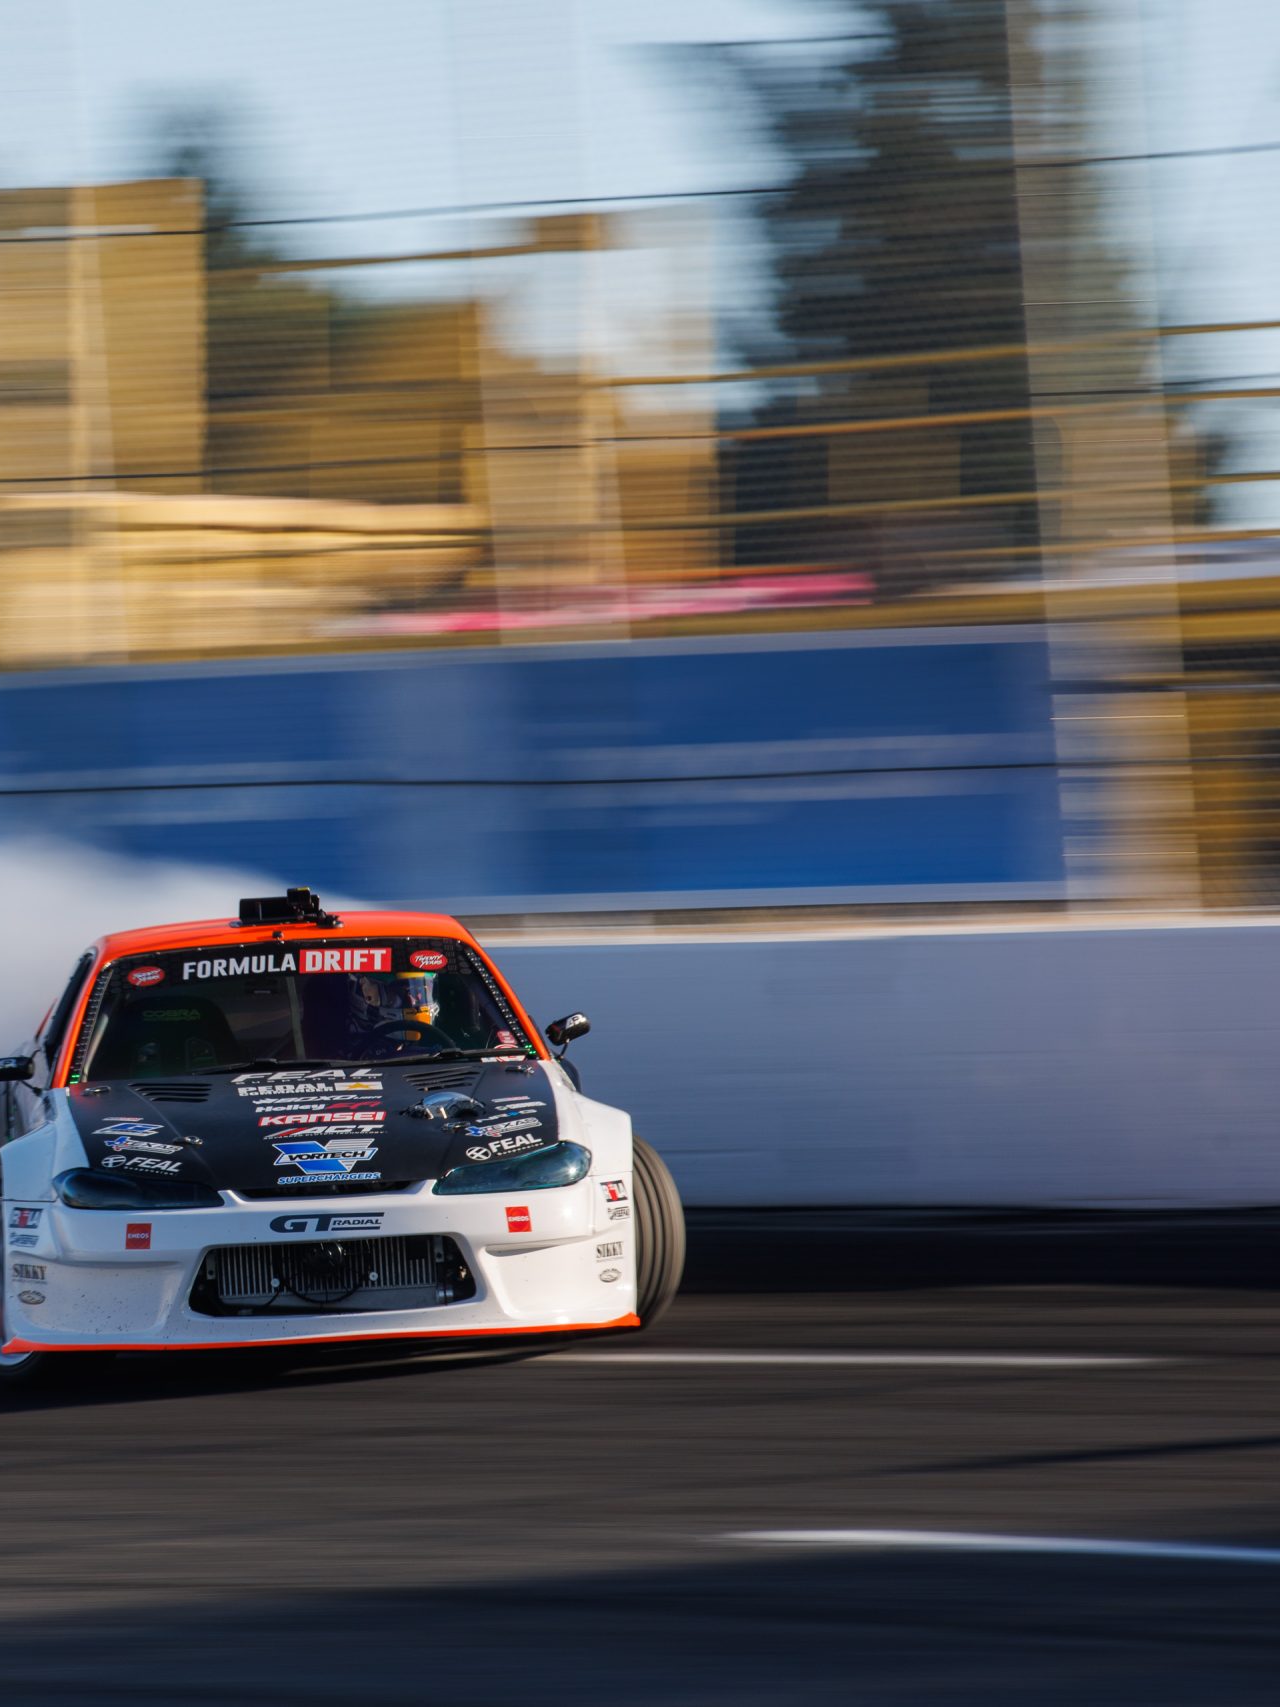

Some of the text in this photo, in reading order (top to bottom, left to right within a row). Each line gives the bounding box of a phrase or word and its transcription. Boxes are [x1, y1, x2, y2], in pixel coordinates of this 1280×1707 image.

[182, 950, 387, 981] FORMULA DRIFT
[231, 1069, 383, 1083] FEAL
[255, 1103, 326, 1113] Holley
[258, 1111, 387, 1127] KANSEI
[488, 1133, 543, 1153] FEAL
[288, 1150, 366, 1161] VORTECH
[124, 1156, 183, 1173] FEAL
[277, 1172, 382, 1185] SUPERCHARGERS
[332, 1218, 383, 1226] RADIAL
